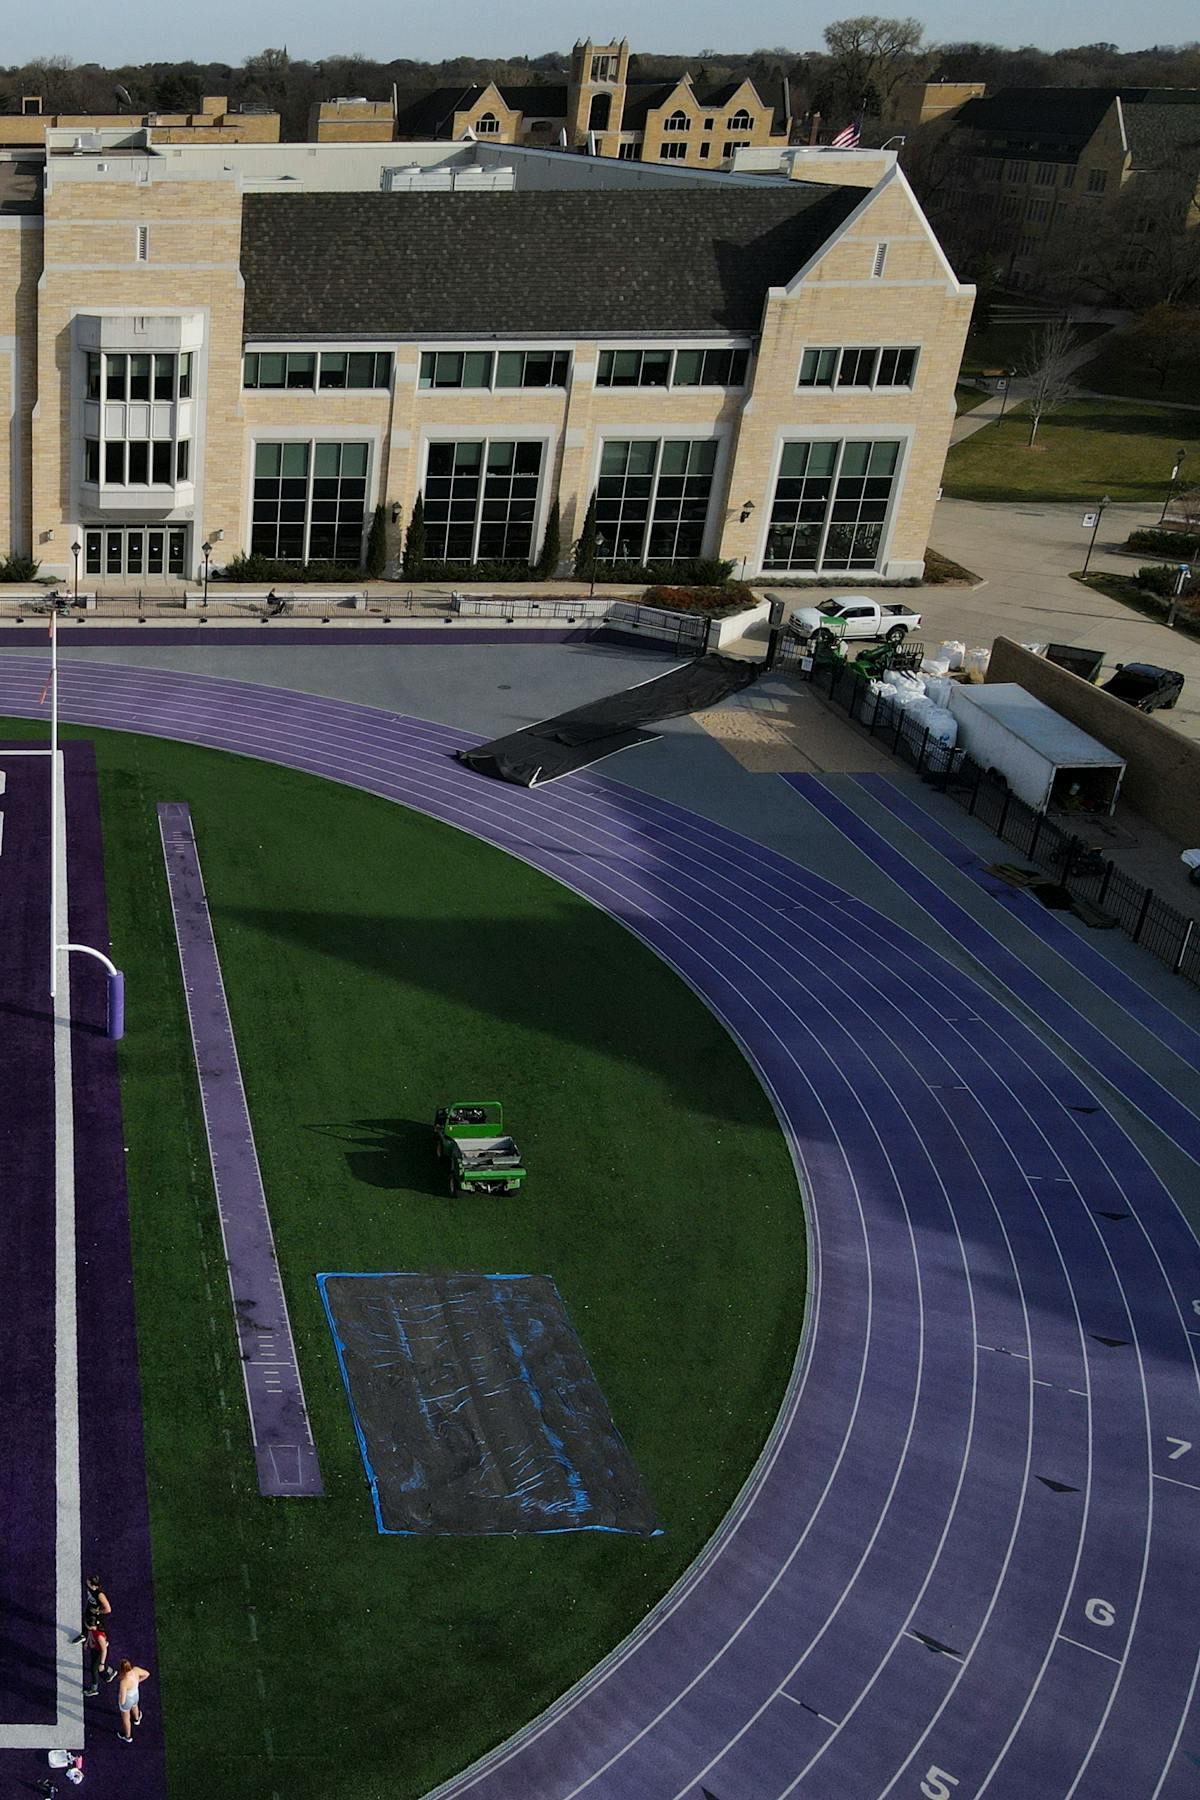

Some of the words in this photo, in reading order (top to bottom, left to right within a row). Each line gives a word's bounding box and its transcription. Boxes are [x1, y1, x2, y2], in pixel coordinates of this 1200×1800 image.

[1166, 1436, 1192, 1460] 7
[1084, 1598, 1116, 1627] 6
[919, 1764, 960, 1800] 5
